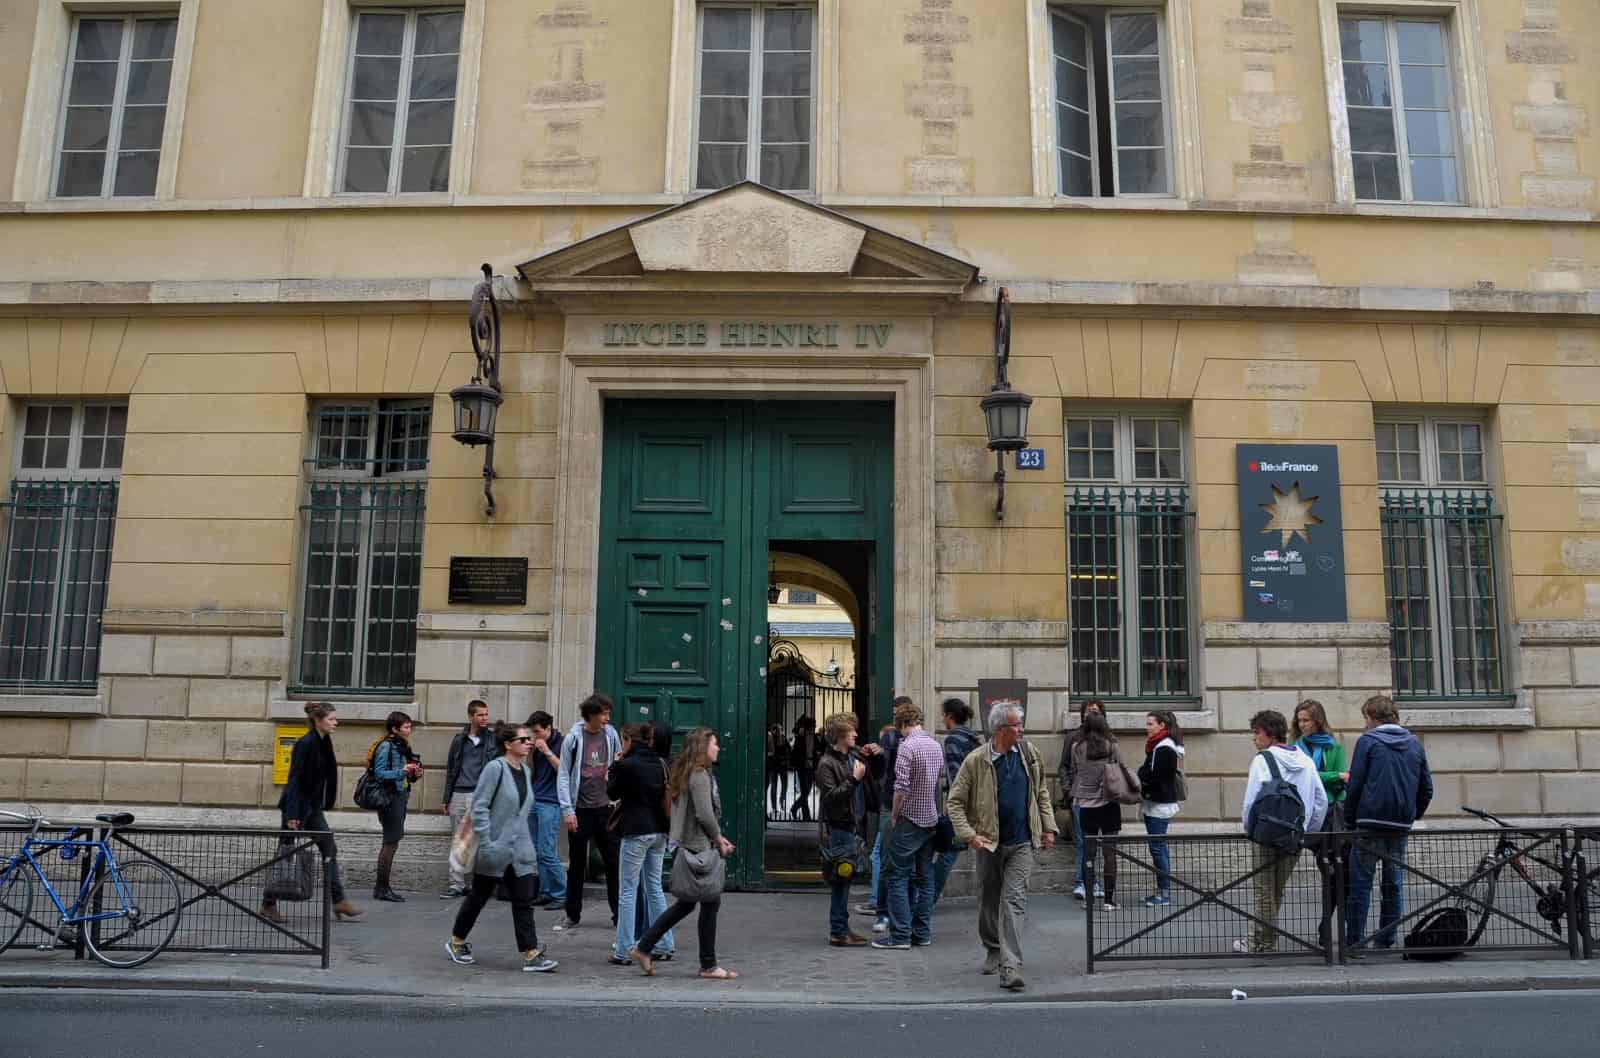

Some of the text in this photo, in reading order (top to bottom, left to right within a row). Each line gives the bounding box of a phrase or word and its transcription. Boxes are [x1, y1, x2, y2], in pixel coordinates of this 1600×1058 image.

[604, 323, 894, 348] LYCEE HENRI IV
[1020, 451, 1040, 466] 23
